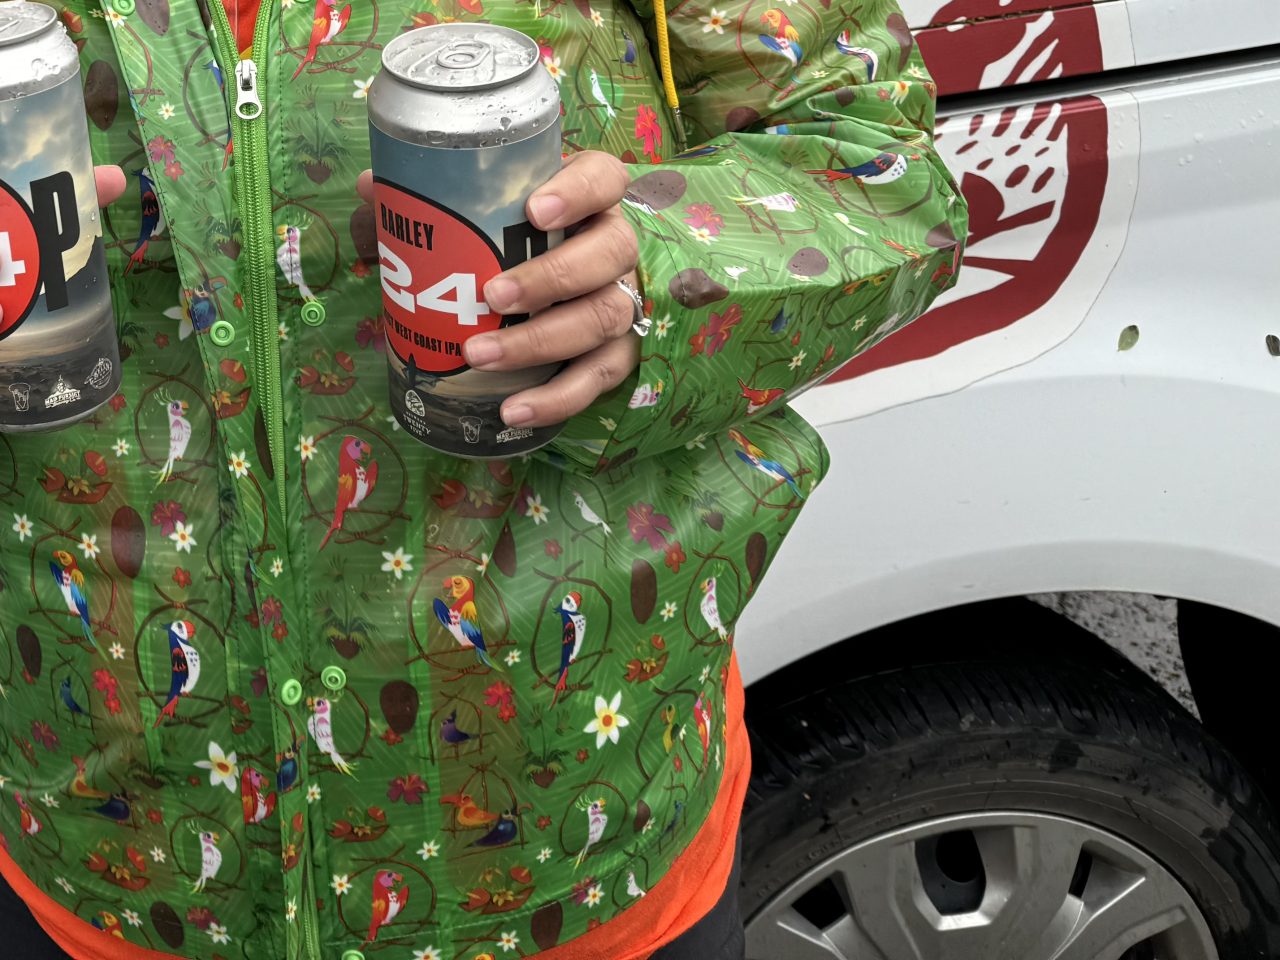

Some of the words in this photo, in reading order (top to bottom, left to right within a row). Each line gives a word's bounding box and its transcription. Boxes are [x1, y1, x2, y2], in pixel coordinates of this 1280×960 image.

[380, 202, 434, 251] BARLEY
[378, 241, 490, 326] 24
[413, 331, 442, 354] COAST
[445, 341, 463, 357] IPA
